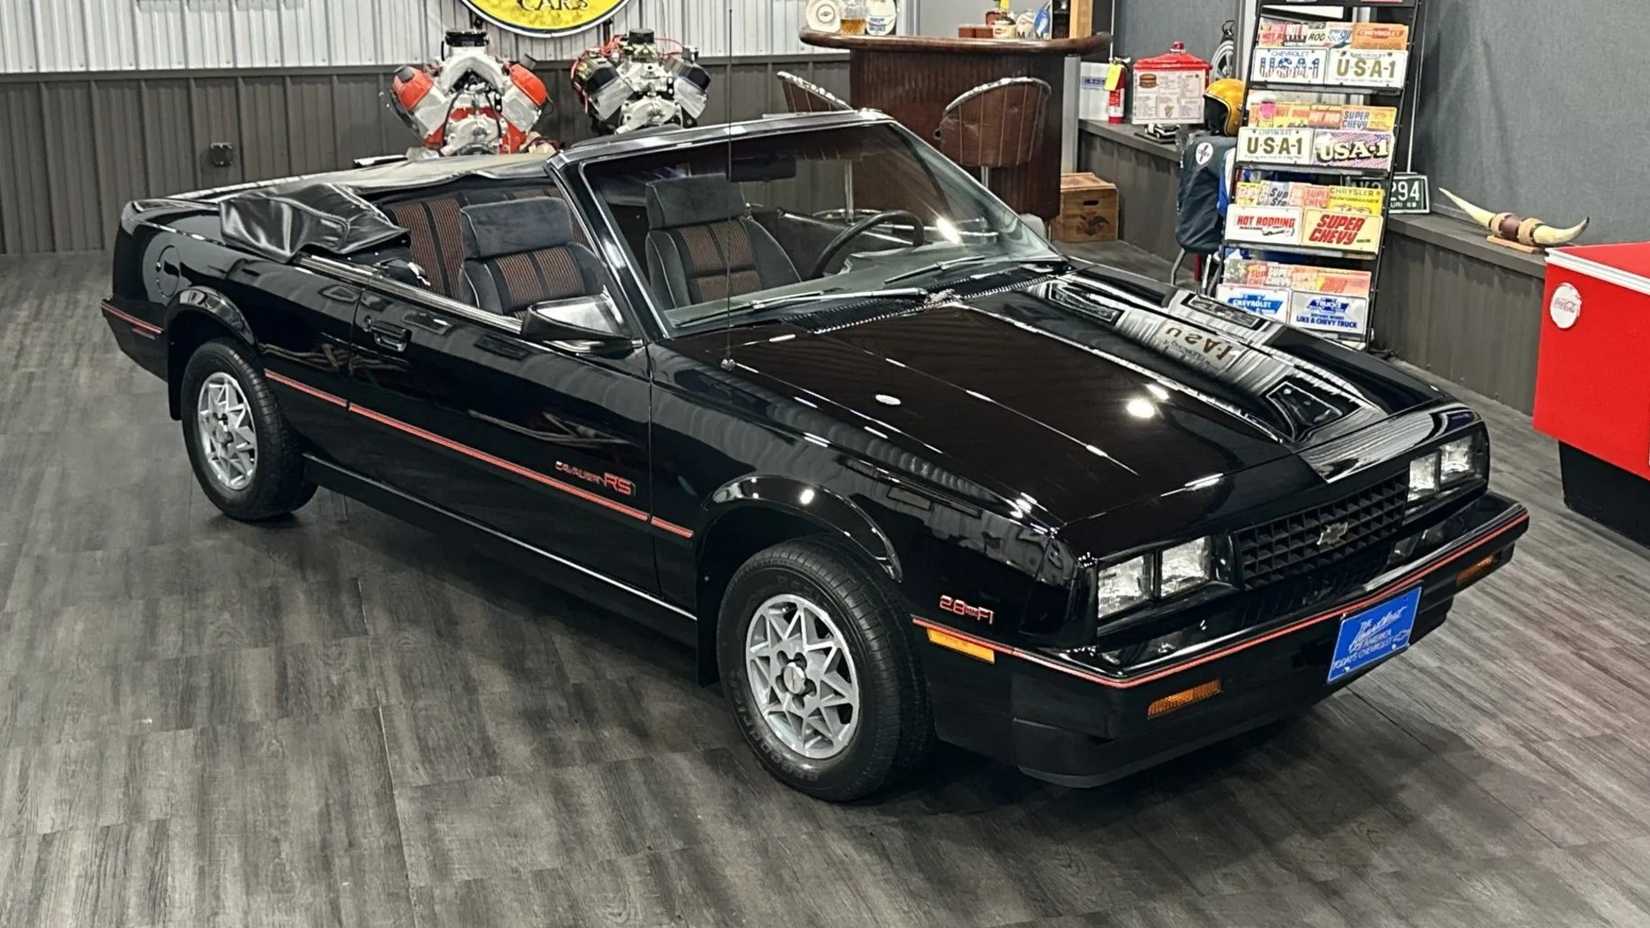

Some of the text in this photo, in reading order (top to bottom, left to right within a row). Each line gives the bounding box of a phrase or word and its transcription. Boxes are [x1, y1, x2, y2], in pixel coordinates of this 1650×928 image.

[1237, 215, 1296, 229] HOT RODDING
[1317, 214, 1365, 232] SUPER
[1309, 228, 1358, 245] CHEVY
[1296, 315, 1310, 323] LIKE
[1316, 318, 1336, 327] CHEVY
[1337, 320, 1357, 329] TRUCK
